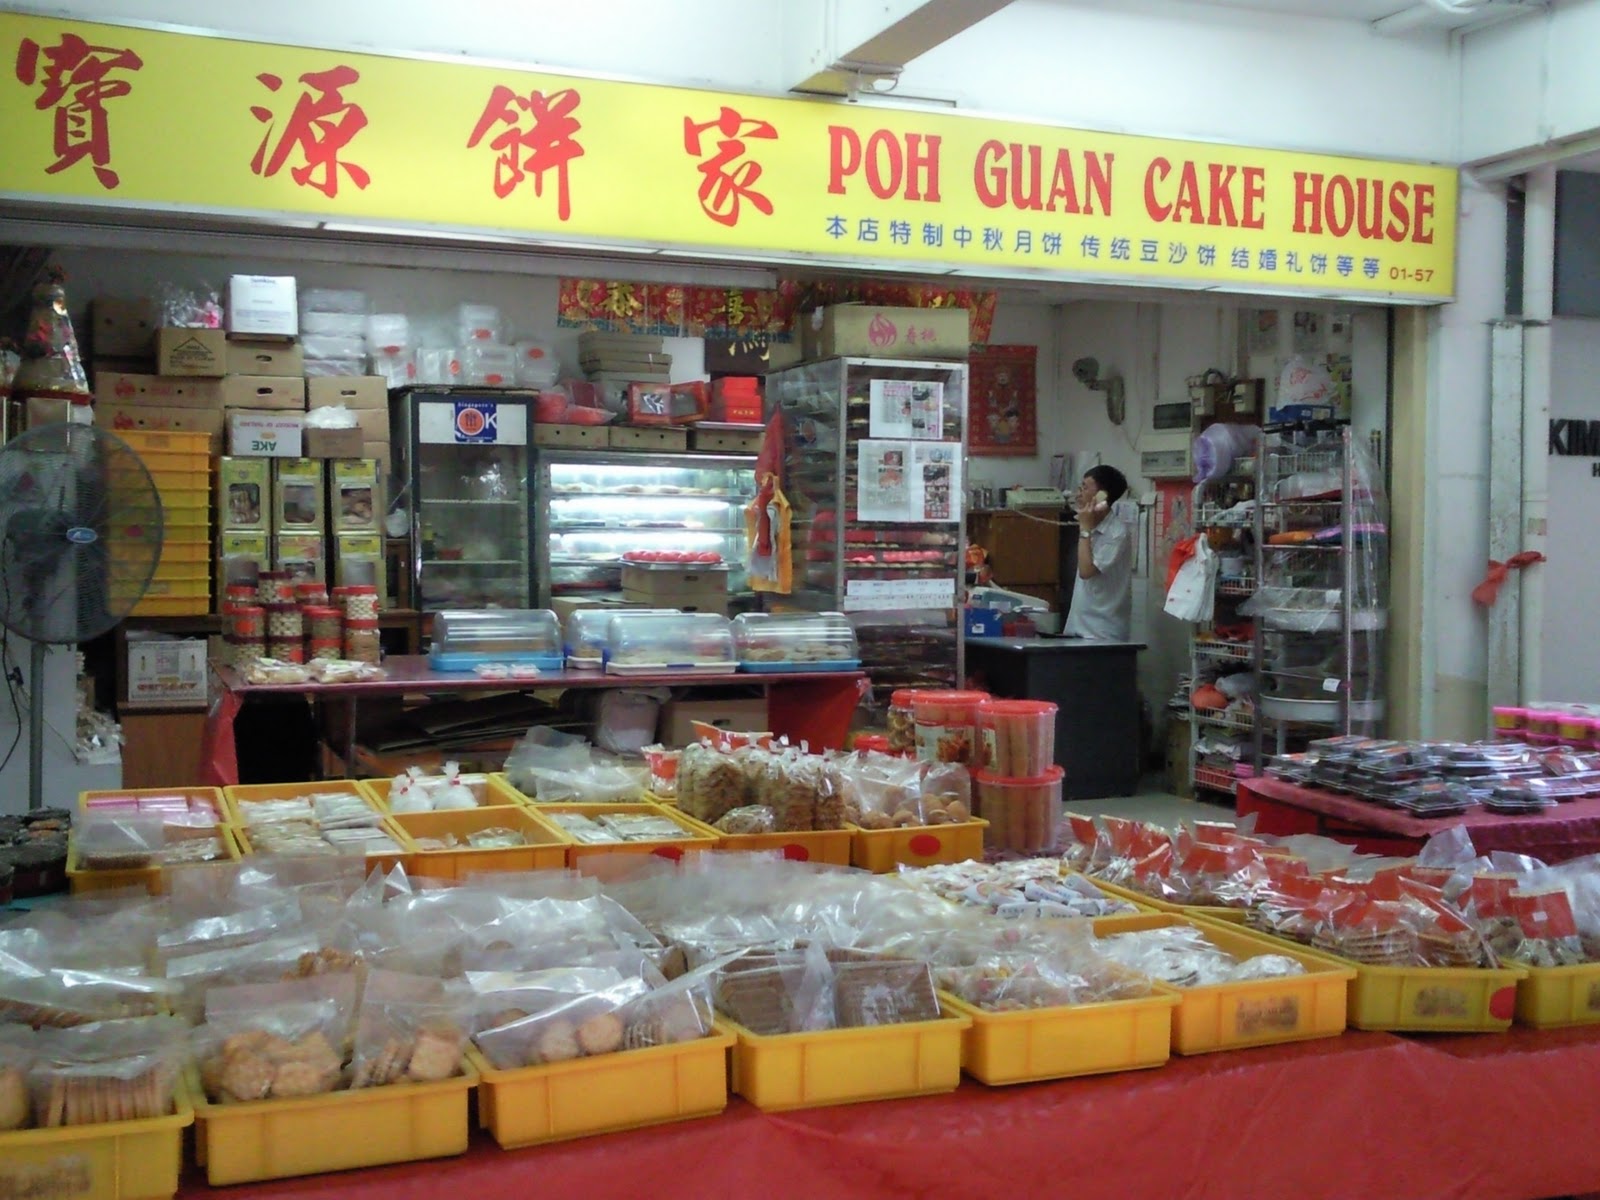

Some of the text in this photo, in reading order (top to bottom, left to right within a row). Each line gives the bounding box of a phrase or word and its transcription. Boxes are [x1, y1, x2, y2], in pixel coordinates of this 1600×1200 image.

[16, 33, 777, 226] 寶源餅家
[827, 126, 1435, 244] POH GUAN CAKE HOUSE
[825, 215, 1381, 279] 本店特制中秋月饼 传统豆沙饼 结婚礼饼等等
[1390, 267, 1435, 282] 01-57
[252, 440, 277, 451] AKE
